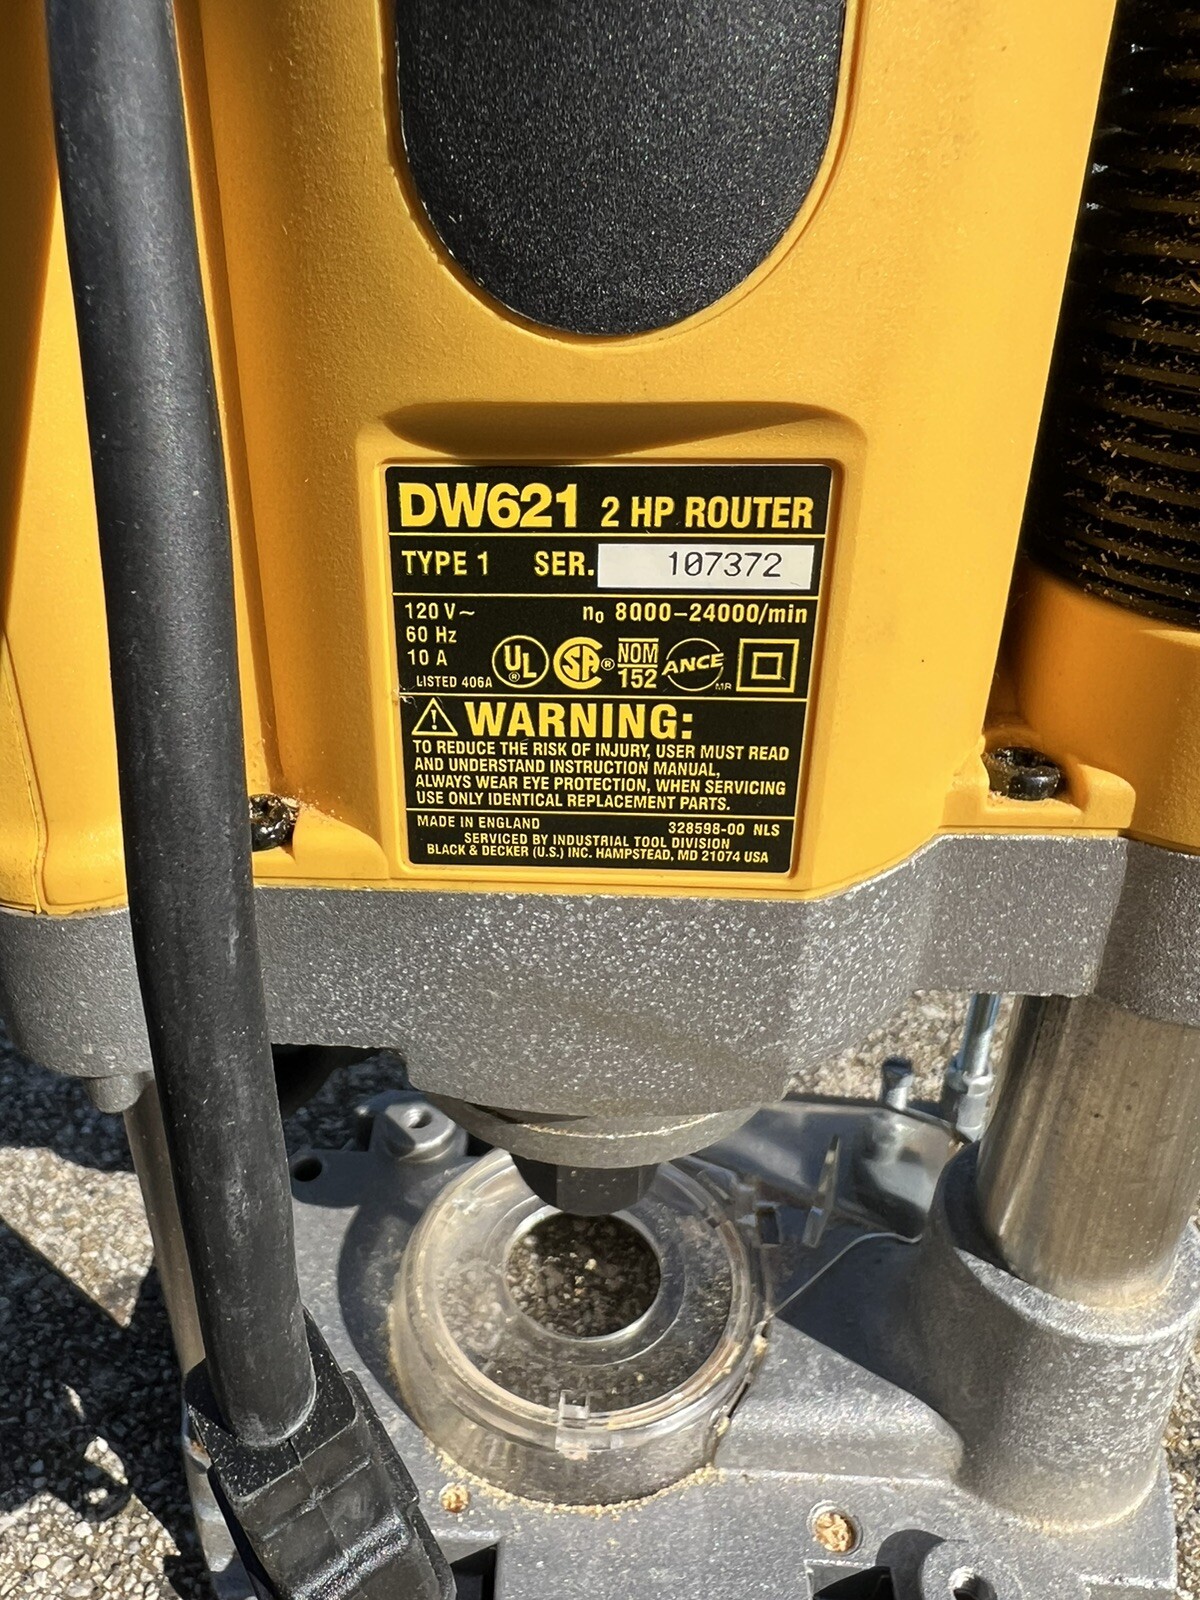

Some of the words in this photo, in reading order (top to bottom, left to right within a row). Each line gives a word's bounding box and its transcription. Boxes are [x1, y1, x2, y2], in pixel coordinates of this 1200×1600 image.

[398, 483, 577, 528] DW621
[601, 496, 620, 527] 2
[631, 496, 675, 527] HP
[685, 497, 814, 528] ROUTER
[401, 551, 467, 576] TYPE
[477, 551, 488, 575] 1
[534, 551, 594, 577] SER.
[668, 552, 782, 577] 107372
[405, 602, 439, 620] 120
[406, 626, 428, 643] 60
[436, 627, 457, 643] Hz
[407, 649, 429, 666] 10
[436, 650, 448, 666] A
[617, 643, 658, 663] NOM
[662, 653, 724, 675] ANCE
[416, 675, 457, 687] LISTED
[461, 676, 493, 688] 406A
[618, 669, 657, 688] 152
[464, 702, 693, 739] WARNING:
[413, 740, 432, 754] TO
[436, 740, 495, 755] REDUCE
[500, 741, 528, 755] THE
[533, 742, 567, 756] RISK
[571, 743, 591, 756] OF
[596, 743, 650, 760] INJURY,
[656, 745, 695, 759] USER
[700, 745, 744, 759] MUST
[749, 746, 789, 760] READ
[415, 757, 444, 771] AND
[449, 758, 545, 773] UNDERSTAND
[550, 760, 648, 775] INSTRUCTION
[415, 774, 471, 788] ALWAYS
[476, 775, 518, 789] WEAR
[523, 776, 549, 790] EYE
[554, 777, 650, 794] PROTECTION,
[656, 779, 700, 793] WHEN
[705, 780, 786, 795] SERVICING
[416, 791, 444, 804] USE
[449, 792, 484, 805] ONLY
[488, 793, 563, 807] IDENTICAL
[567, 794, 676, 809] REPLACEMENT
[680, 796, 730, 811] PARTS.
[417, 815, 455, 827] MADE
[460, 817, 473, 828] IN
[478, 817, 540, 829] ENGLAND
[668, 822, 745, 836] 328598-00
[753, 824, 780, 836] NLS
[464, 833, 528, 845] SERVICED
[533, 834, 548, 845] BY
[553, 835, 629, 847] INDUSTRIAL
[634, 836, 667, 848] TOOL
[672, 837, 730, 849] DIVISION
[427, 844, 465, 855] BLACK
[469, 845, 477, 856] &
[482, 845, 529, 857] DECKER
[533, 846, 564, 859] (U.S.)
[568, 847, 592, 859] INC.
[596, 848, 674, 861] HAMPSTEAD,
[678, 850, 698, 861] MD
[701, 850, 741, 862] 21074
[744, 851, 769, 863] USA
